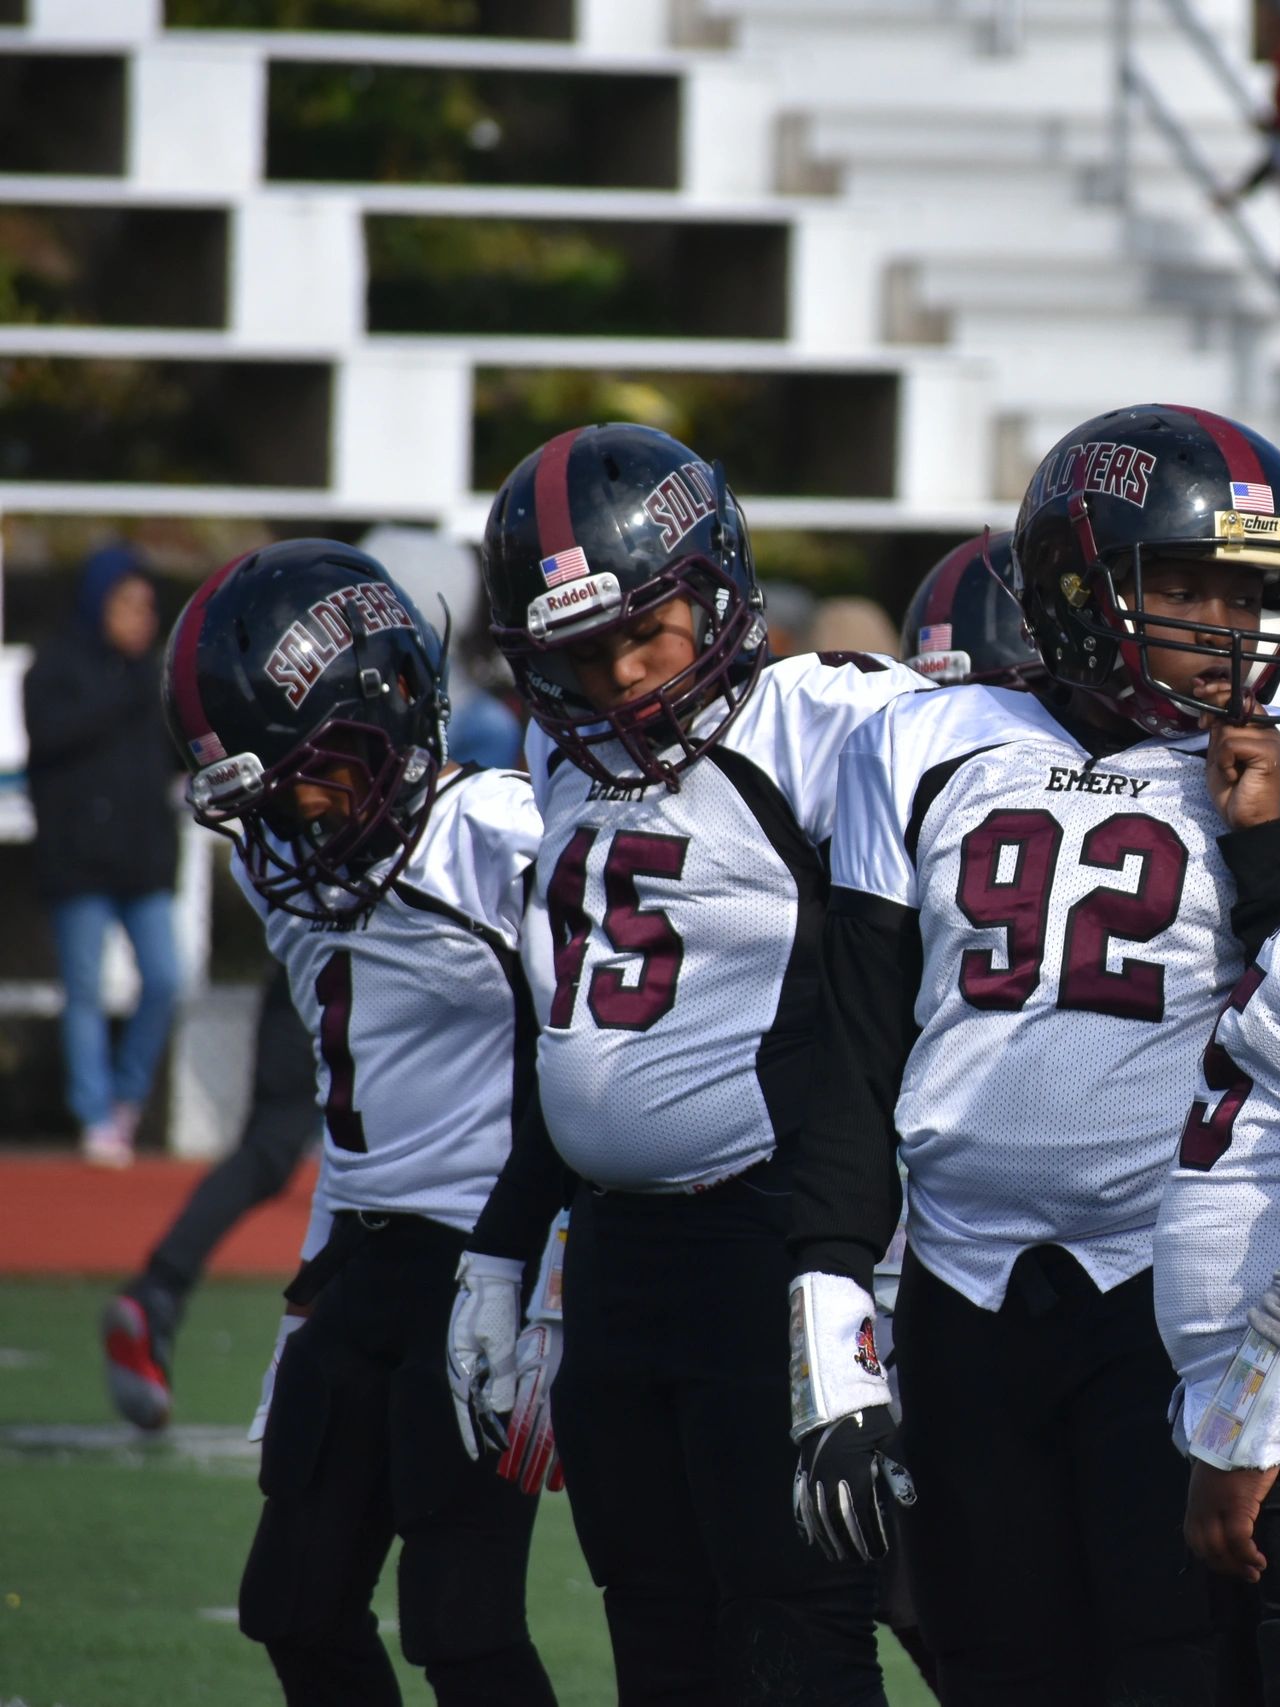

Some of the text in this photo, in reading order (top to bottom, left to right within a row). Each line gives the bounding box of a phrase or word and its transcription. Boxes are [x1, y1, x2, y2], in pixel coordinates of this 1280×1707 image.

[546, 580, 599, 612] Riddell
[1045, 766, 1152, 799] EMERY
[955, 808, 1190, 1024] 92
